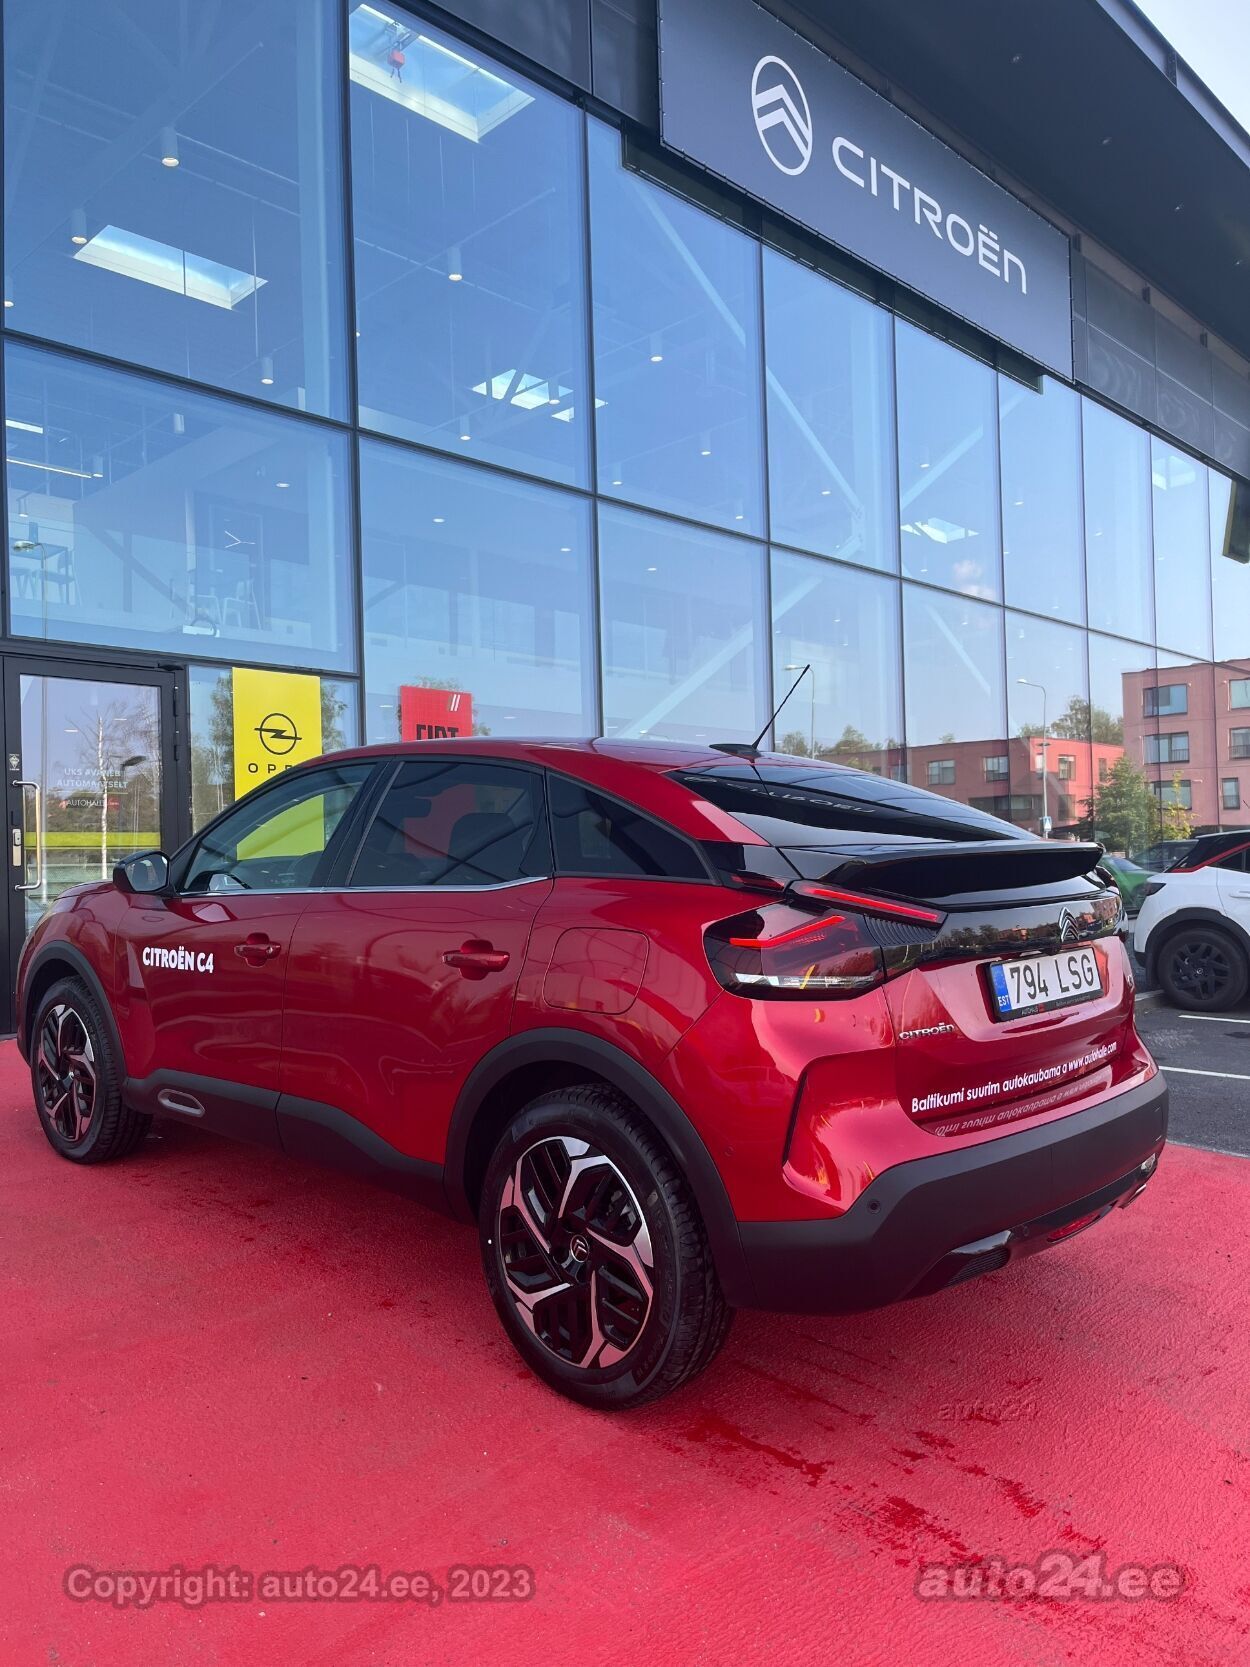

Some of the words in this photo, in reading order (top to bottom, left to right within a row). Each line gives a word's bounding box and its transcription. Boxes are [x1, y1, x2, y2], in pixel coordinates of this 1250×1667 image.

[142, 945, 195, 971] CITROËN
[196, 952, 214, 974] C4
[1009, 961, 1049, 1004] 794
[1054, 953, 1095, 994] LSG
[997, 994, 1010, 1007] EST
[911, 1087, 965, 1113] Baltikumi
[966, 1081, 1000, 1101] suurim
